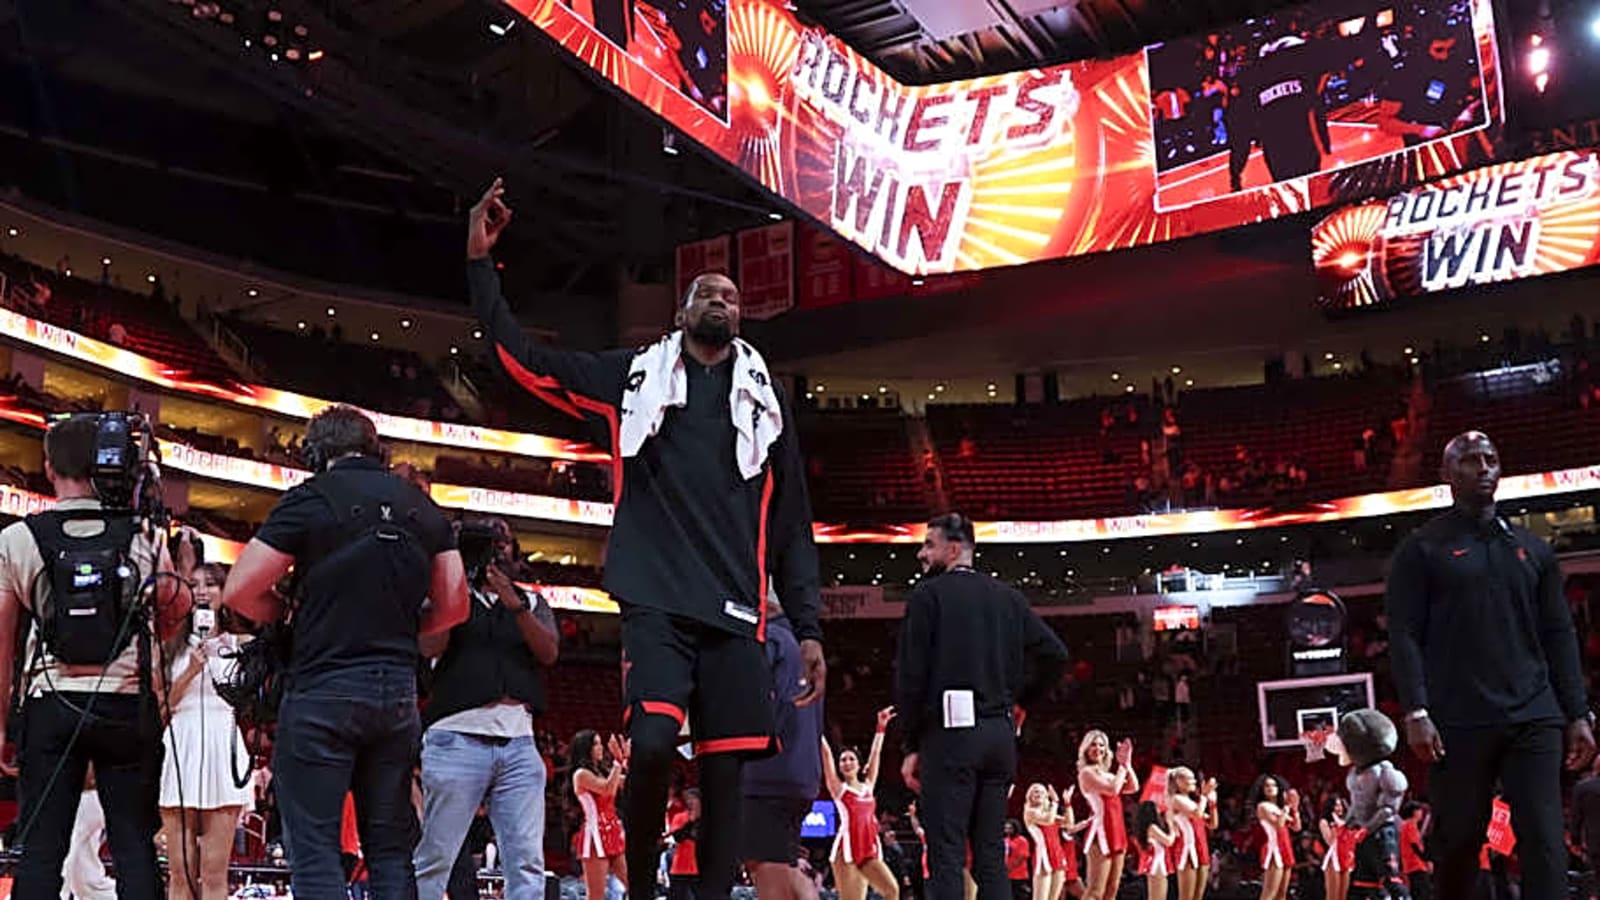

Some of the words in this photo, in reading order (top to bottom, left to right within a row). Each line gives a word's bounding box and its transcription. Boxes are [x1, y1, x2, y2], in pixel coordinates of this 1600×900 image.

[793, 29, 1073, 152] ROCKETS
[833, 142, 967, 267] WIN
[1386, 154, 1596, 227] ROCKETS
[1424, 219, 1534, 284] WIN
[40, 322, 77, 350] WIN
